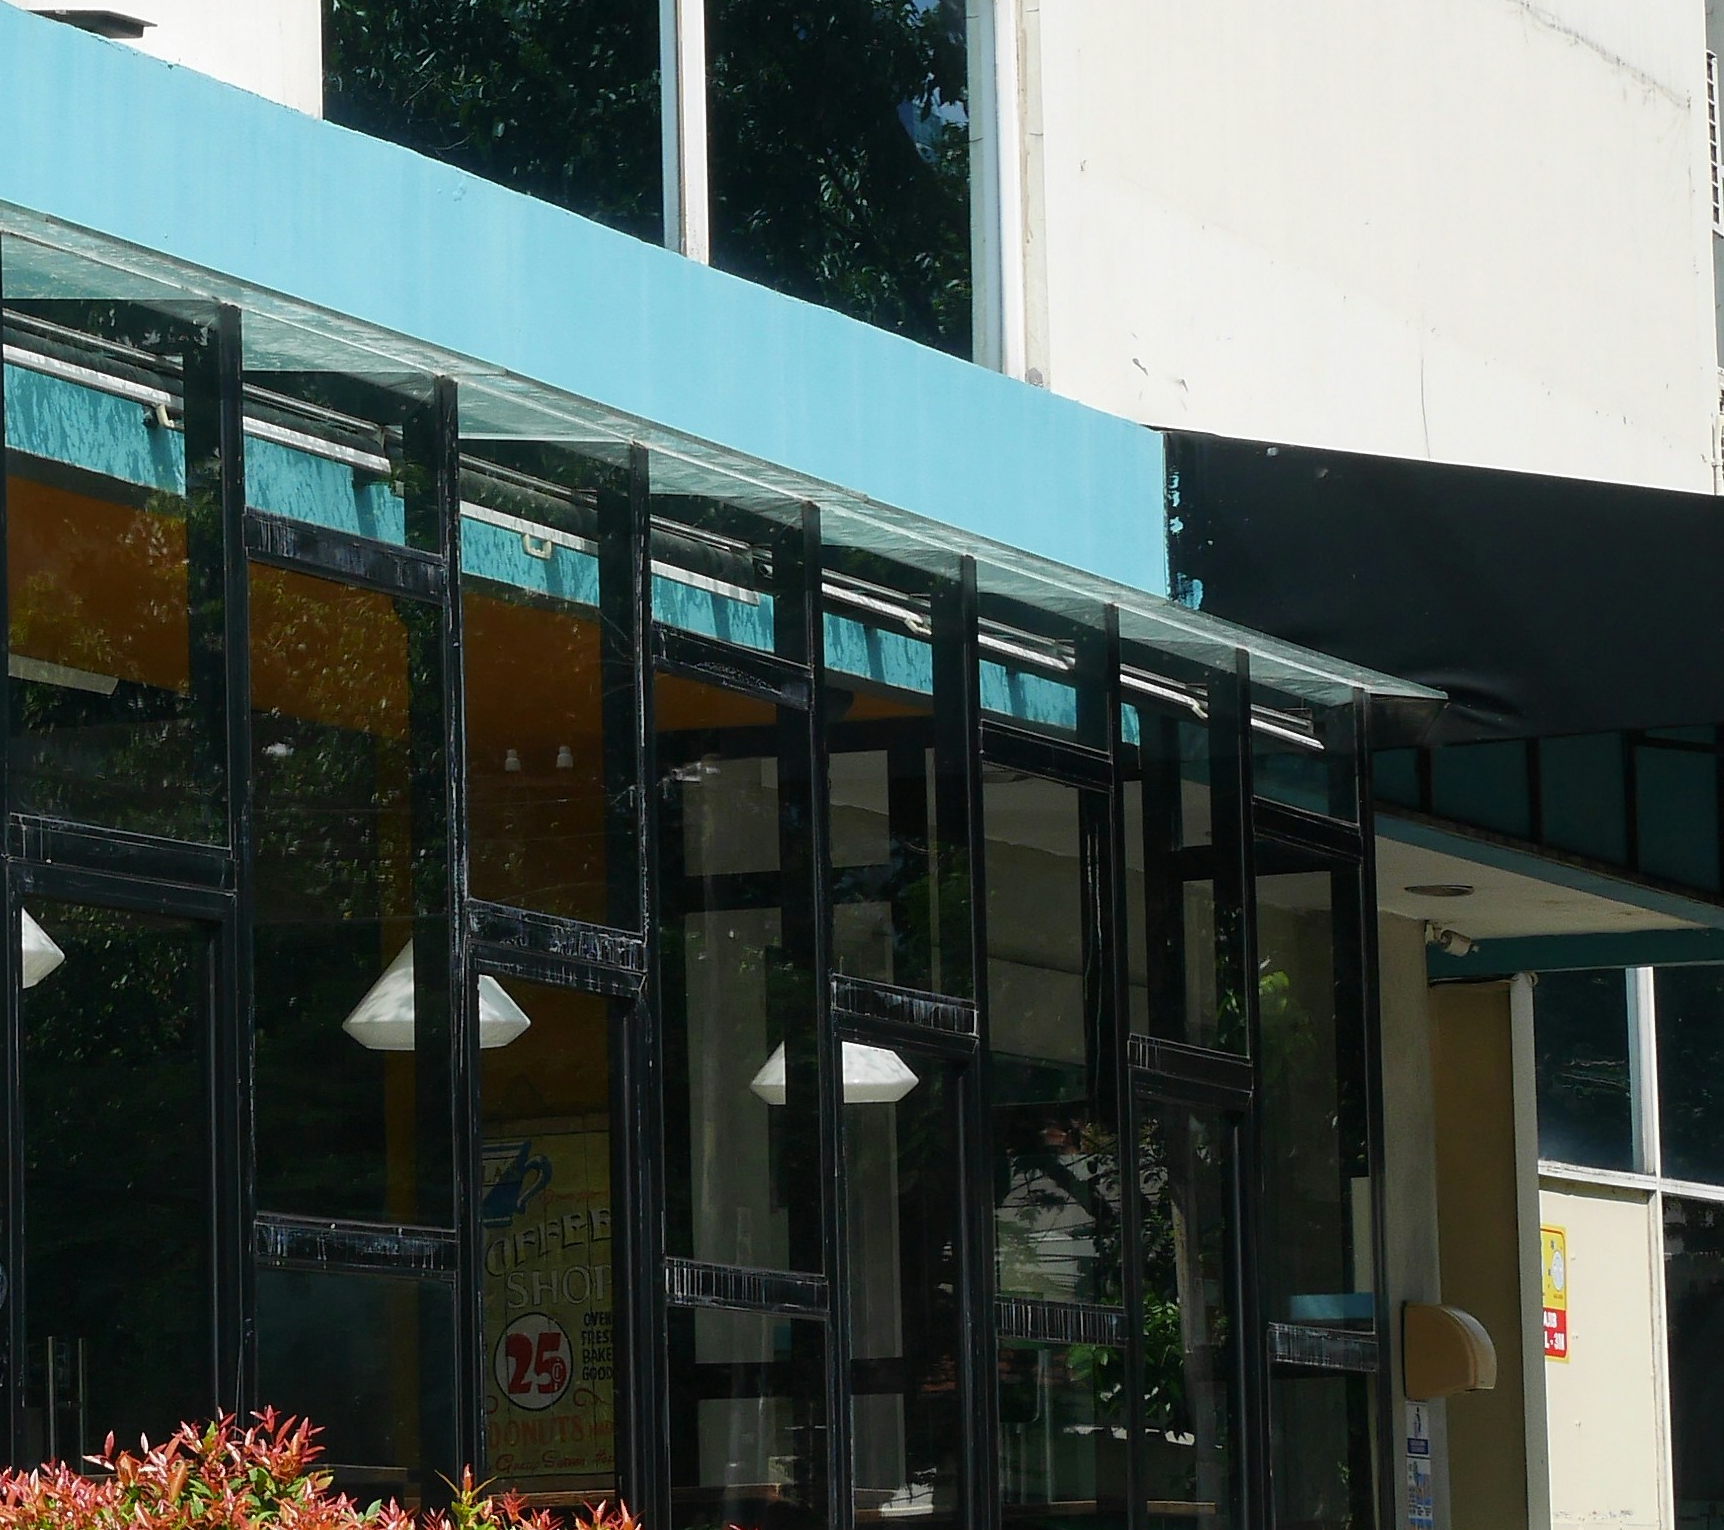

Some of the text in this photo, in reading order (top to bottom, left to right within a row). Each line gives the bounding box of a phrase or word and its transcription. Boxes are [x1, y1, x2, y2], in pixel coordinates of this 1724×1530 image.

[485, 1208, 612, 1277] OFFEE
[506, 1262, 612, 1308] SHOP
[581, 1329, 613, 1345] FRES
[582, 1347, 612, 1364] BAKE
[582, 1366, 612, 1380] GOOD
